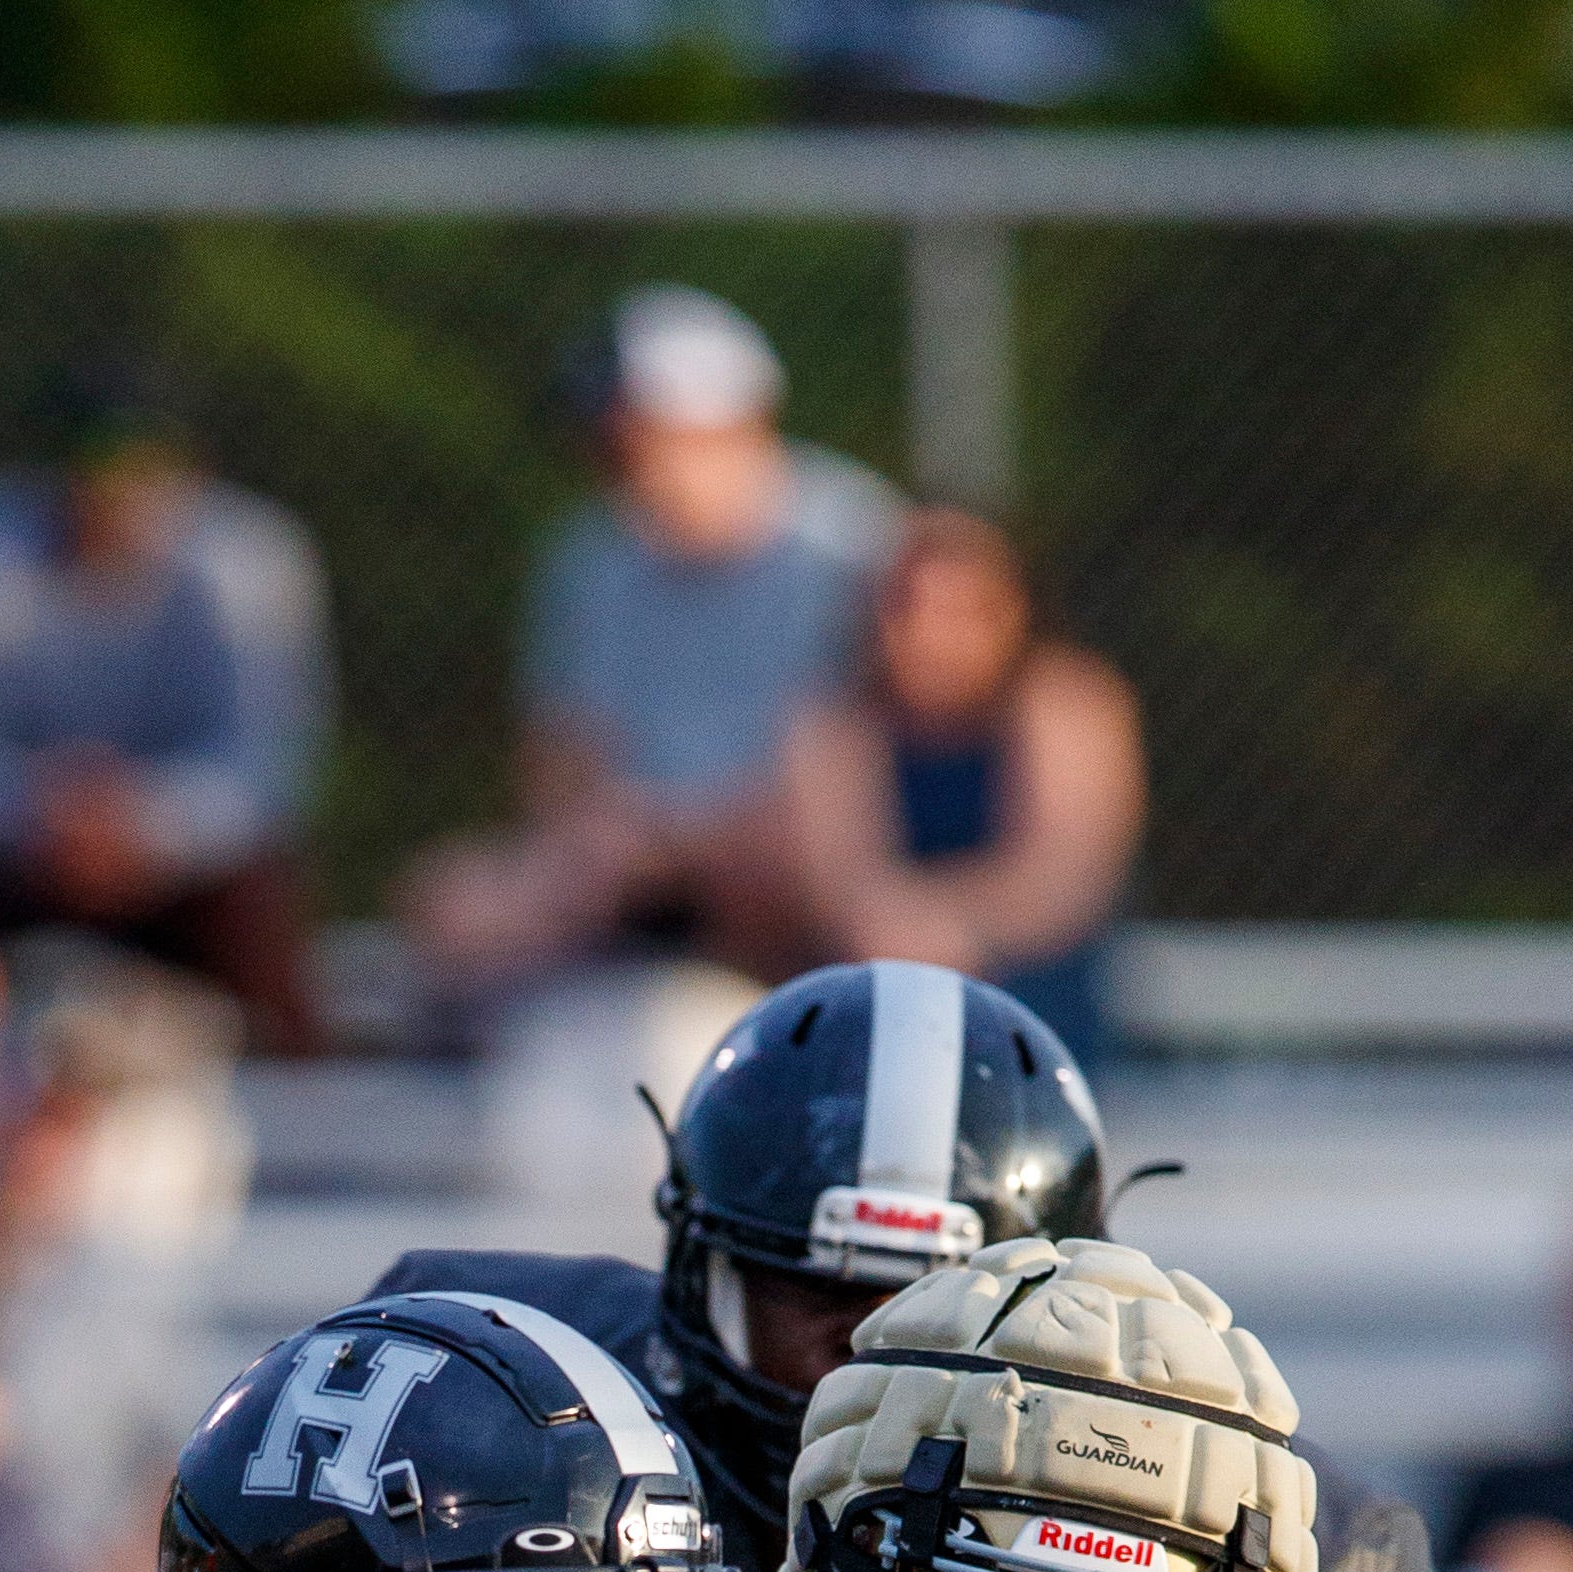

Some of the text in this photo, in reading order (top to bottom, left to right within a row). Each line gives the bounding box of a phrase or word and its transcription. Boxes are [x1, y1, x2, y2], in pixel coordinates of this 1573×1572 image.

[240, 1334, 450, 1514] H
[1056, 1439, 1164, 1477] GUARDIAN
[1038, 1516, 1155, 1568] Riddell
